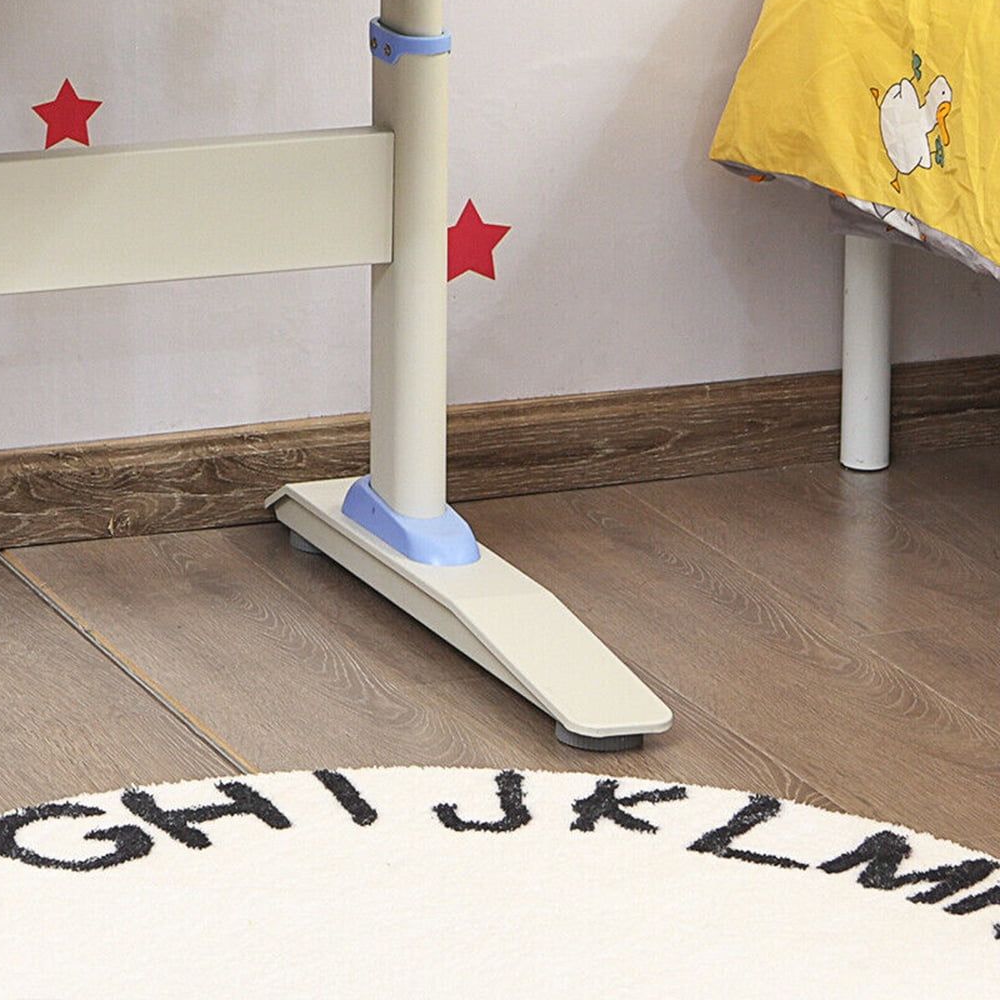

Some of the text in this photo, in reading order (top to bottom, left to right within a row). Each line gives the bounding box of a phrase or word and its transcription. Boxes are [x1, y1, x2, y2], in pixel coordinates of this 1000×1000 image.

[121, 781, 292, 851] H
[432, 769, 532, 834] J
[570, 778, 687, 835] K
[686, 792, 810, 871] L
[816, 830, 1000, 905] M
